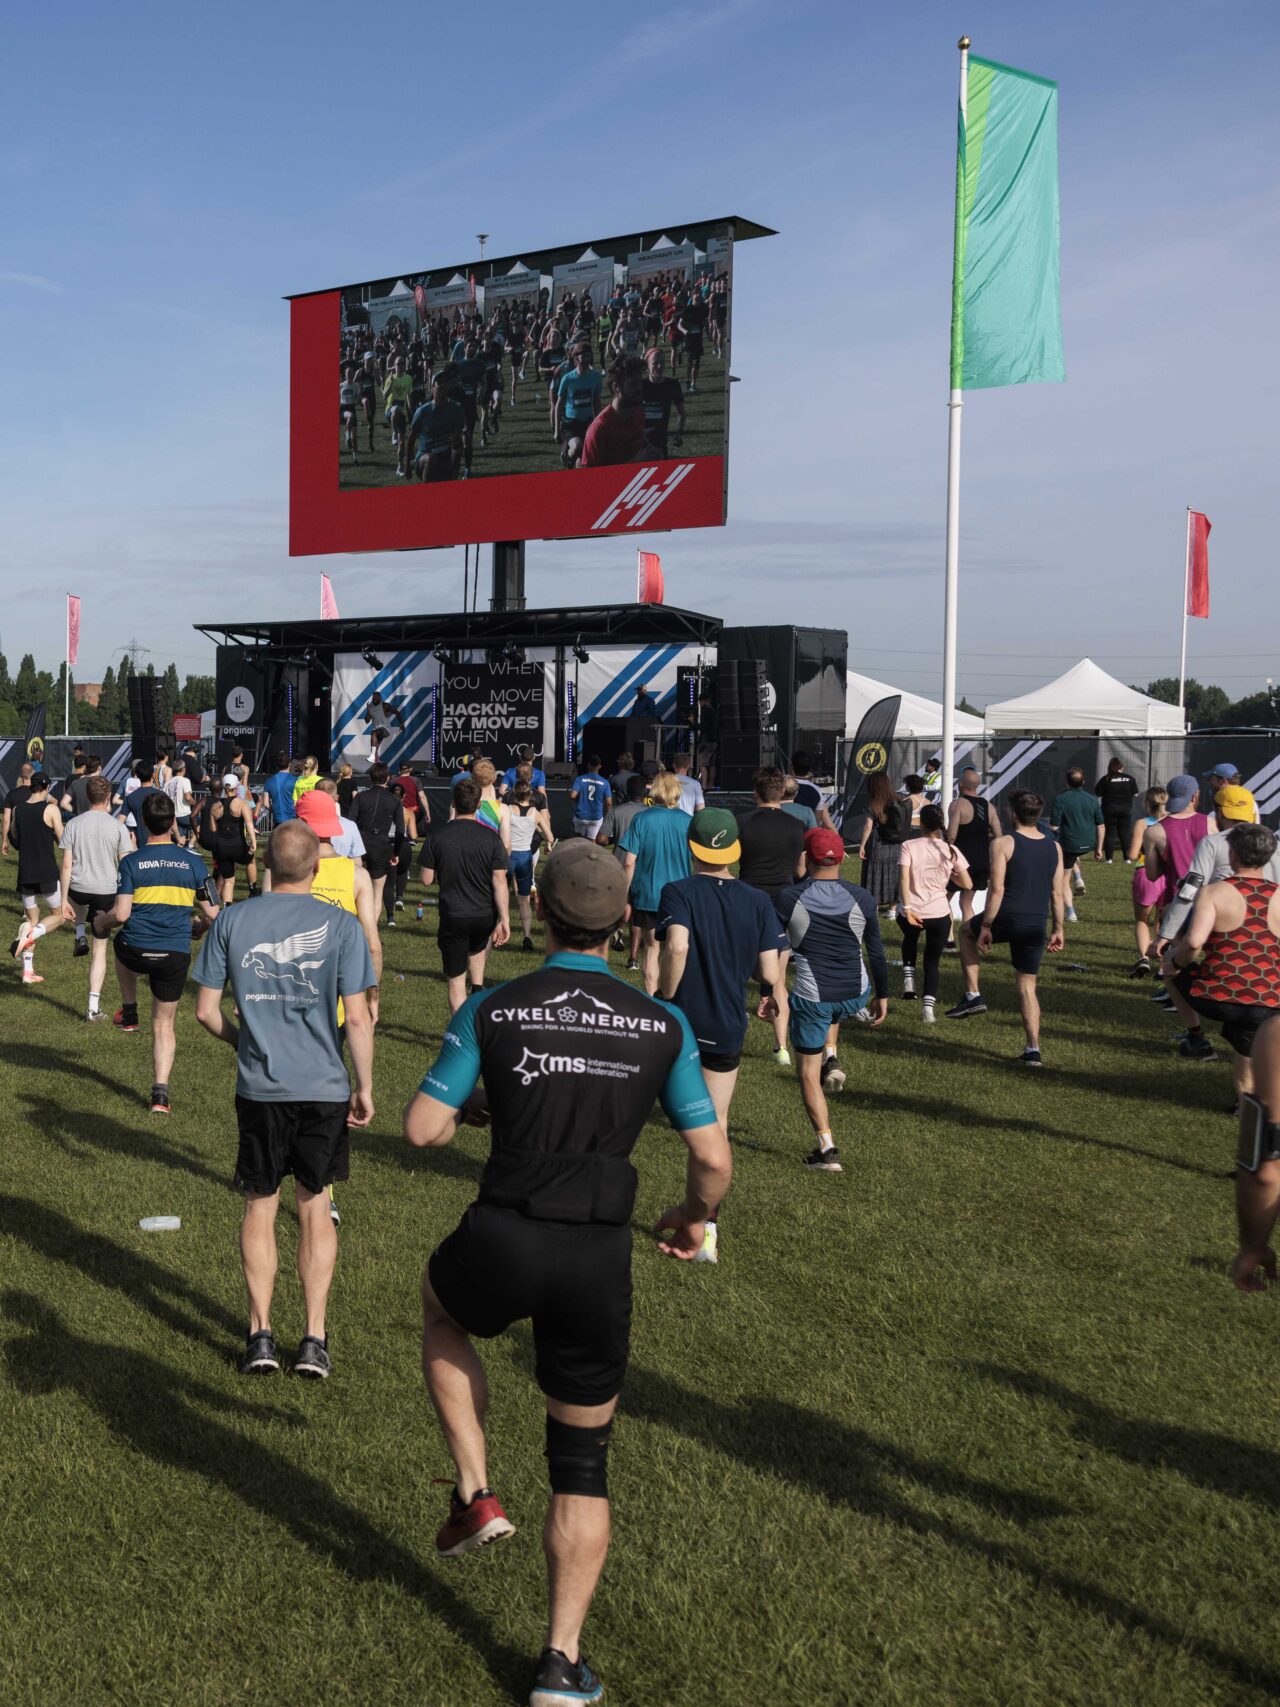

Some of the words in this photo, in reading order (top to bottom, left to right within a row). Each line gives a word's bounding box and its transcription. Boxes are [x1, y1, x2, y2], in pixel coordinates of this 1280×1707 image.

[489, 662, 544, 675] WHEN
[444, 676, 480, 689] YOU
[490, 688, 543, 702] MOVE
[442, 703, 516, 716] HACKN-
[442, 716, 467, 729] EY
[471, 716, 539, 729] MOVES
[443, 730, 498, 743] WHEN
[588, 785, 595, 801] 2
[138, 860, 159, 870] BBVA
[160, 859, 190, 870] Francés
[245, 993, 277, 1002] pegasus
[491, 1007, 555, 1022] CYKEL
[581, 1012, 667, 1034] NERVEN
[566, 1025, 593, 1034] WORLD
[594, 1028, 627, 1038] WITHOUT
[628, 1032, 640, 1040] MS
[549, 1056, 586, 1074] ms
[587, 1058, 640, 1073] international
[586, 1067, 629, 1079] federation
